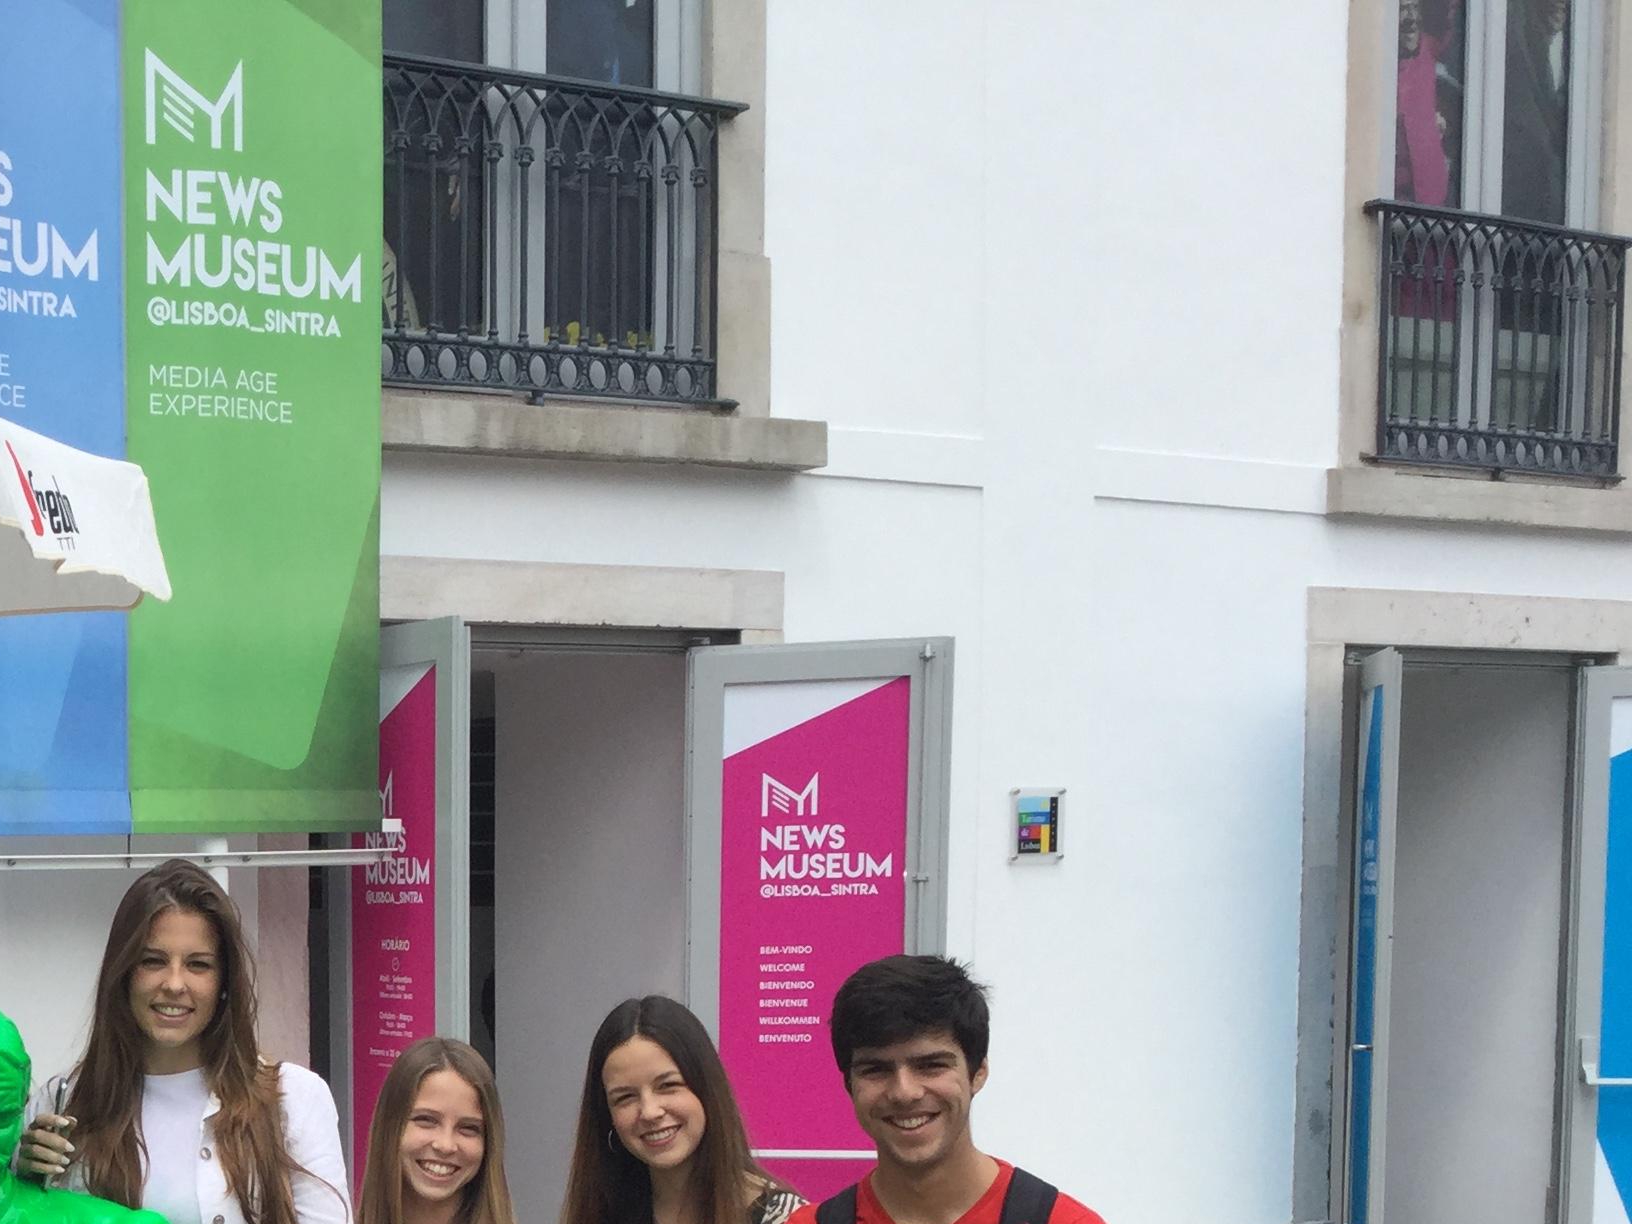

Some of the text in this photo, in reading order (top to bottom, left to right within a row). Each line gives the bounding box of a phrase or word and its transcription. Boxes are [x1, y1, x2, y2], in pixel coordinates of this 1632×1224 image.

[145, 167, 283, 234] NEWS
[146, 231, 362, 303] MUSEUM
[147, 296, 342, 338] @LISBOA_SINTRA
[149, 364, 278, 394] MEDIA AGE
[149, 393, 293, 424] EXPERIENCE
[761, 824, 846, 852] NEWS
[365, 857, 430, 885] MUSEUM
[760, 852, 893, 881] MUSEUM
[759, 882, 879, 898] @LISBOA_SINTRA
[759, 945, 813, 955] BEM-VINDO
[759, 963, 805, 973] WELCOME
[759, 981, 815, 990] BIENVENIDO
[759, 998, 808, 1008] BIENVENUE
[759, 1016, 820, 1025] WILLKOMMEN
[758, 1033, 812, 1043] BENVENUTO
